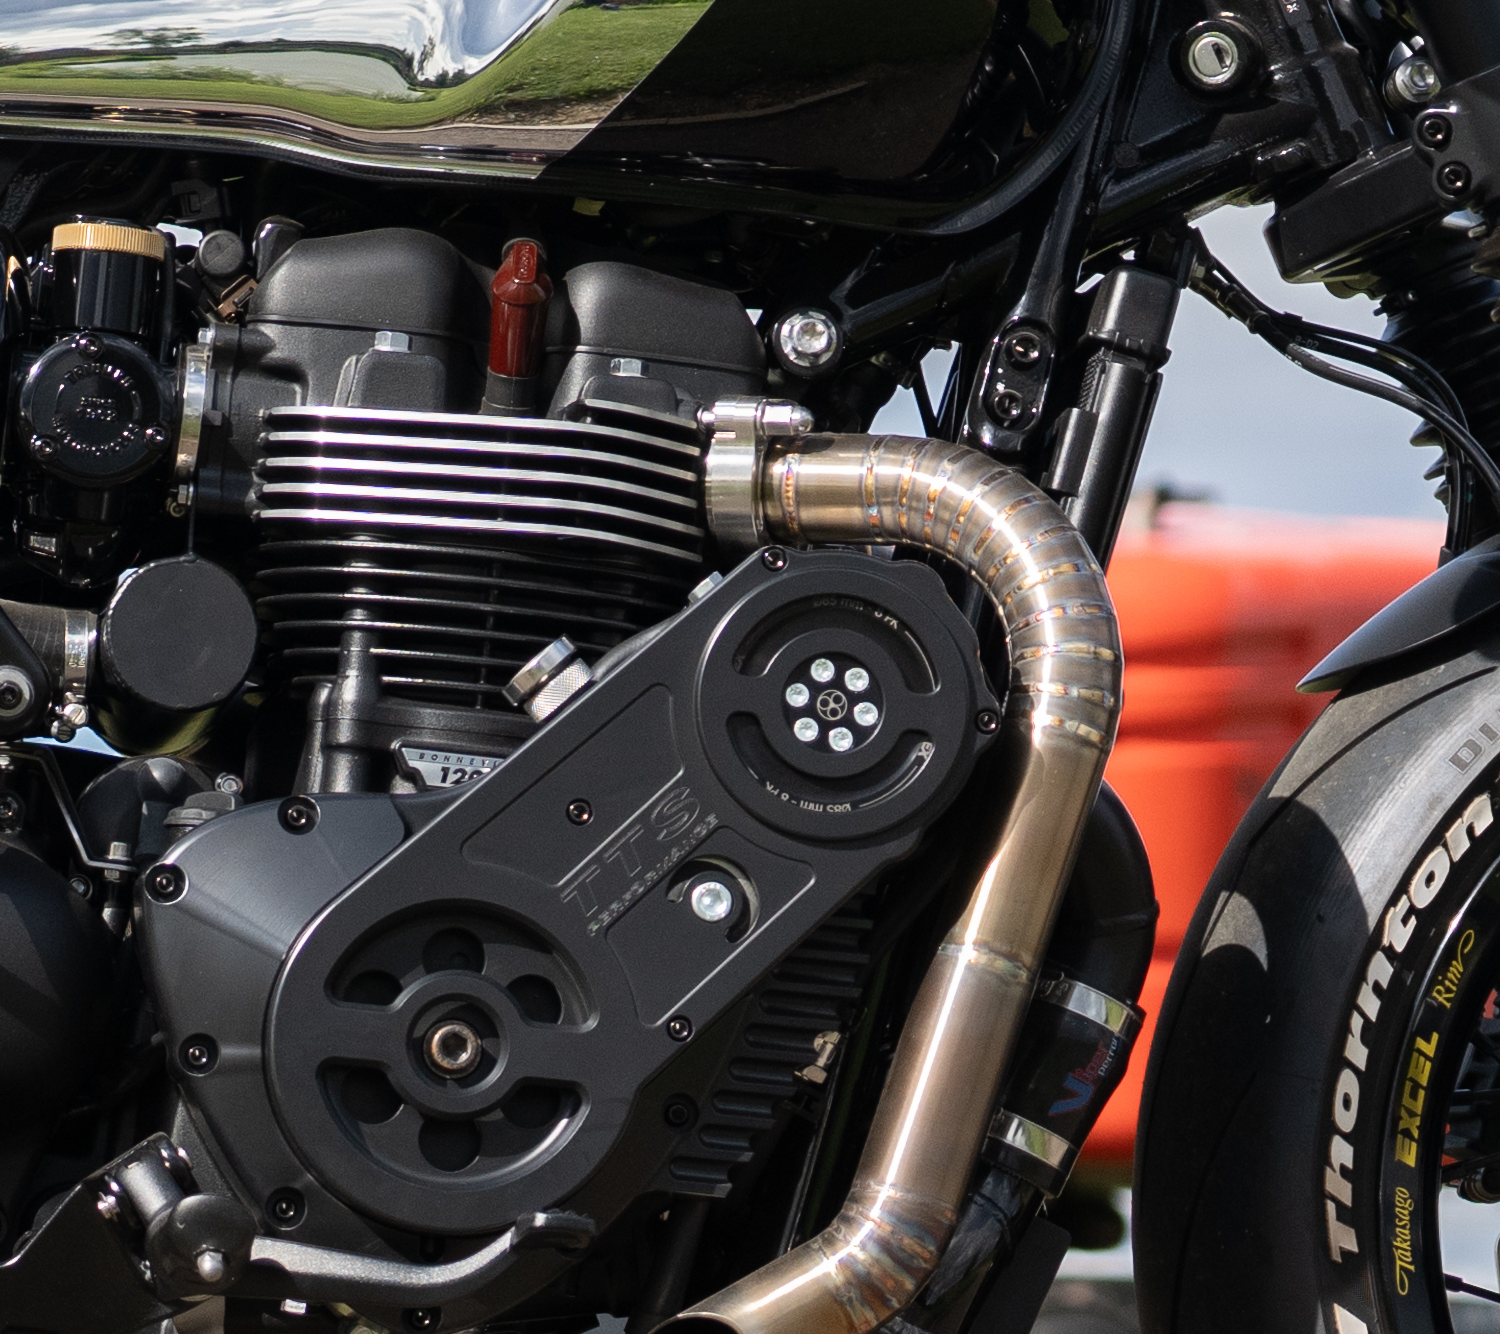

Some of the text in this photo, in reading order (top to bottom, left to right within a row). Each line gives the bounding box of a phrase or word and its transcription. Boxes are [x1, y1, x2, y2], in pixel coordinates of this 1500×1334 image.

[559, 786, 701, 917] TTS
[1322, 792, 1494, 1264] Thornton
[1394, 928, 1476, 1296] Takasago EXCEL Rim
